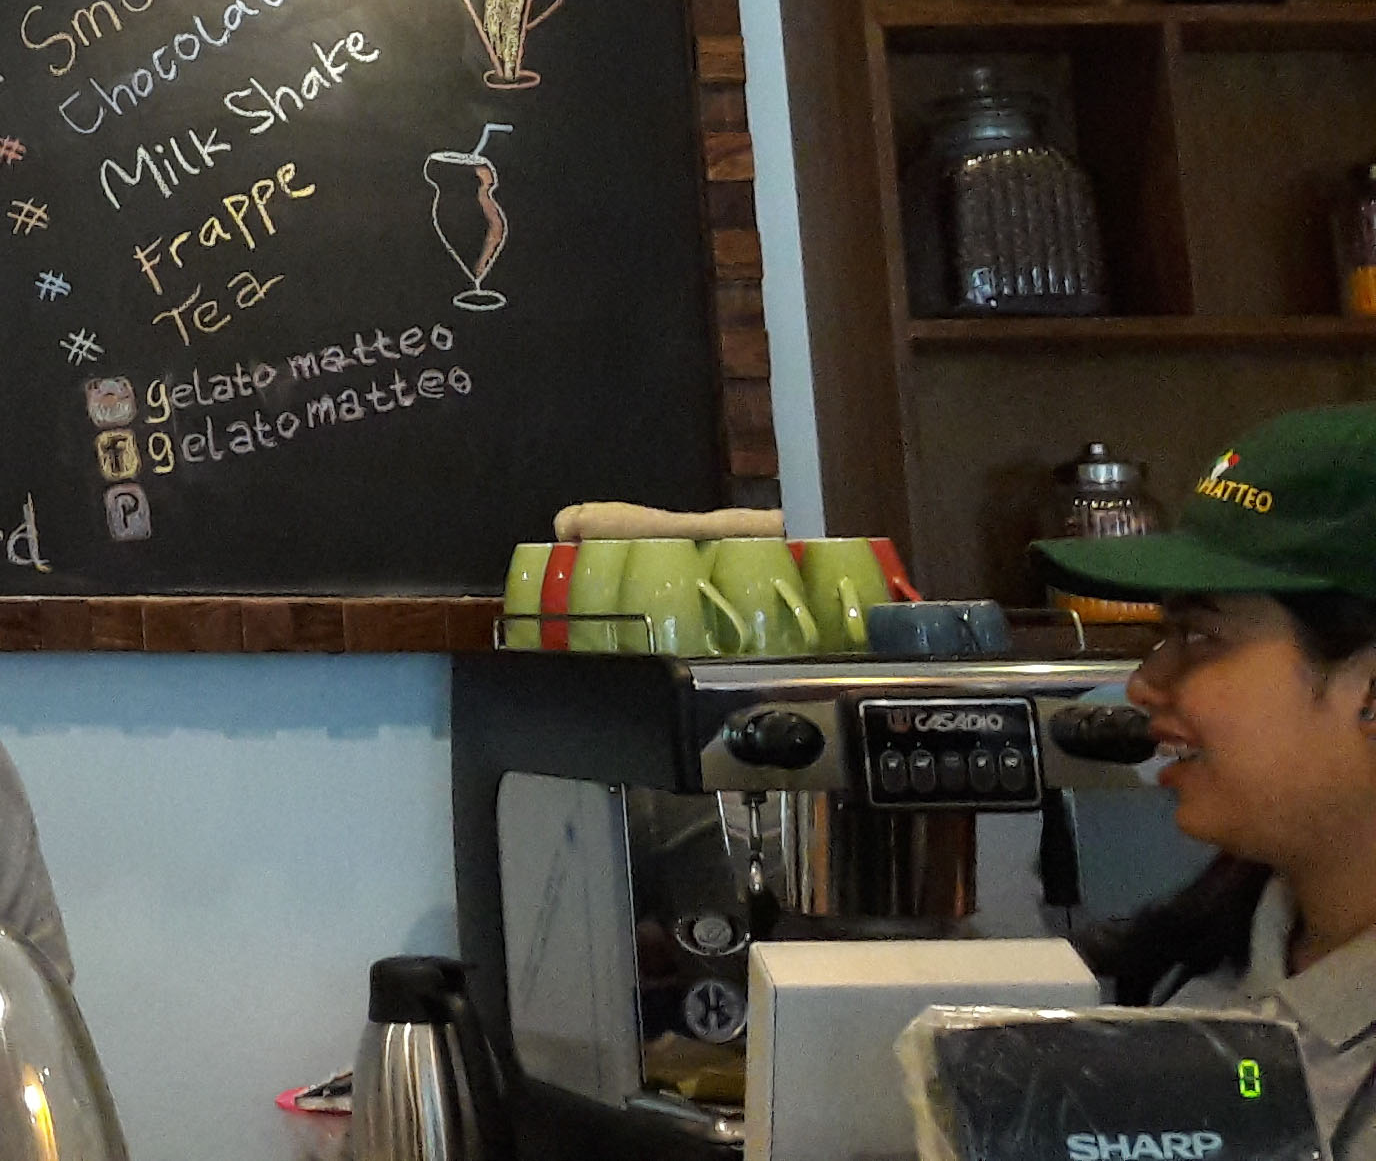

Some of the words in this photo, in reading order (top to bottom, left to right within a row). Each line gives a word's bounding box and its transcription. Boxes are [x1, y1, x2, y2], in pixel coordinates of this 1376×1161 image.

[98, 126, 233, 211] Milk
[132, 161, 317, 296] Frappe
[152, 270, 285, 347] Tea
[1237, 1058, 1262, 1099] 0
[1066, 1132, 1223, 1161] SHARP
